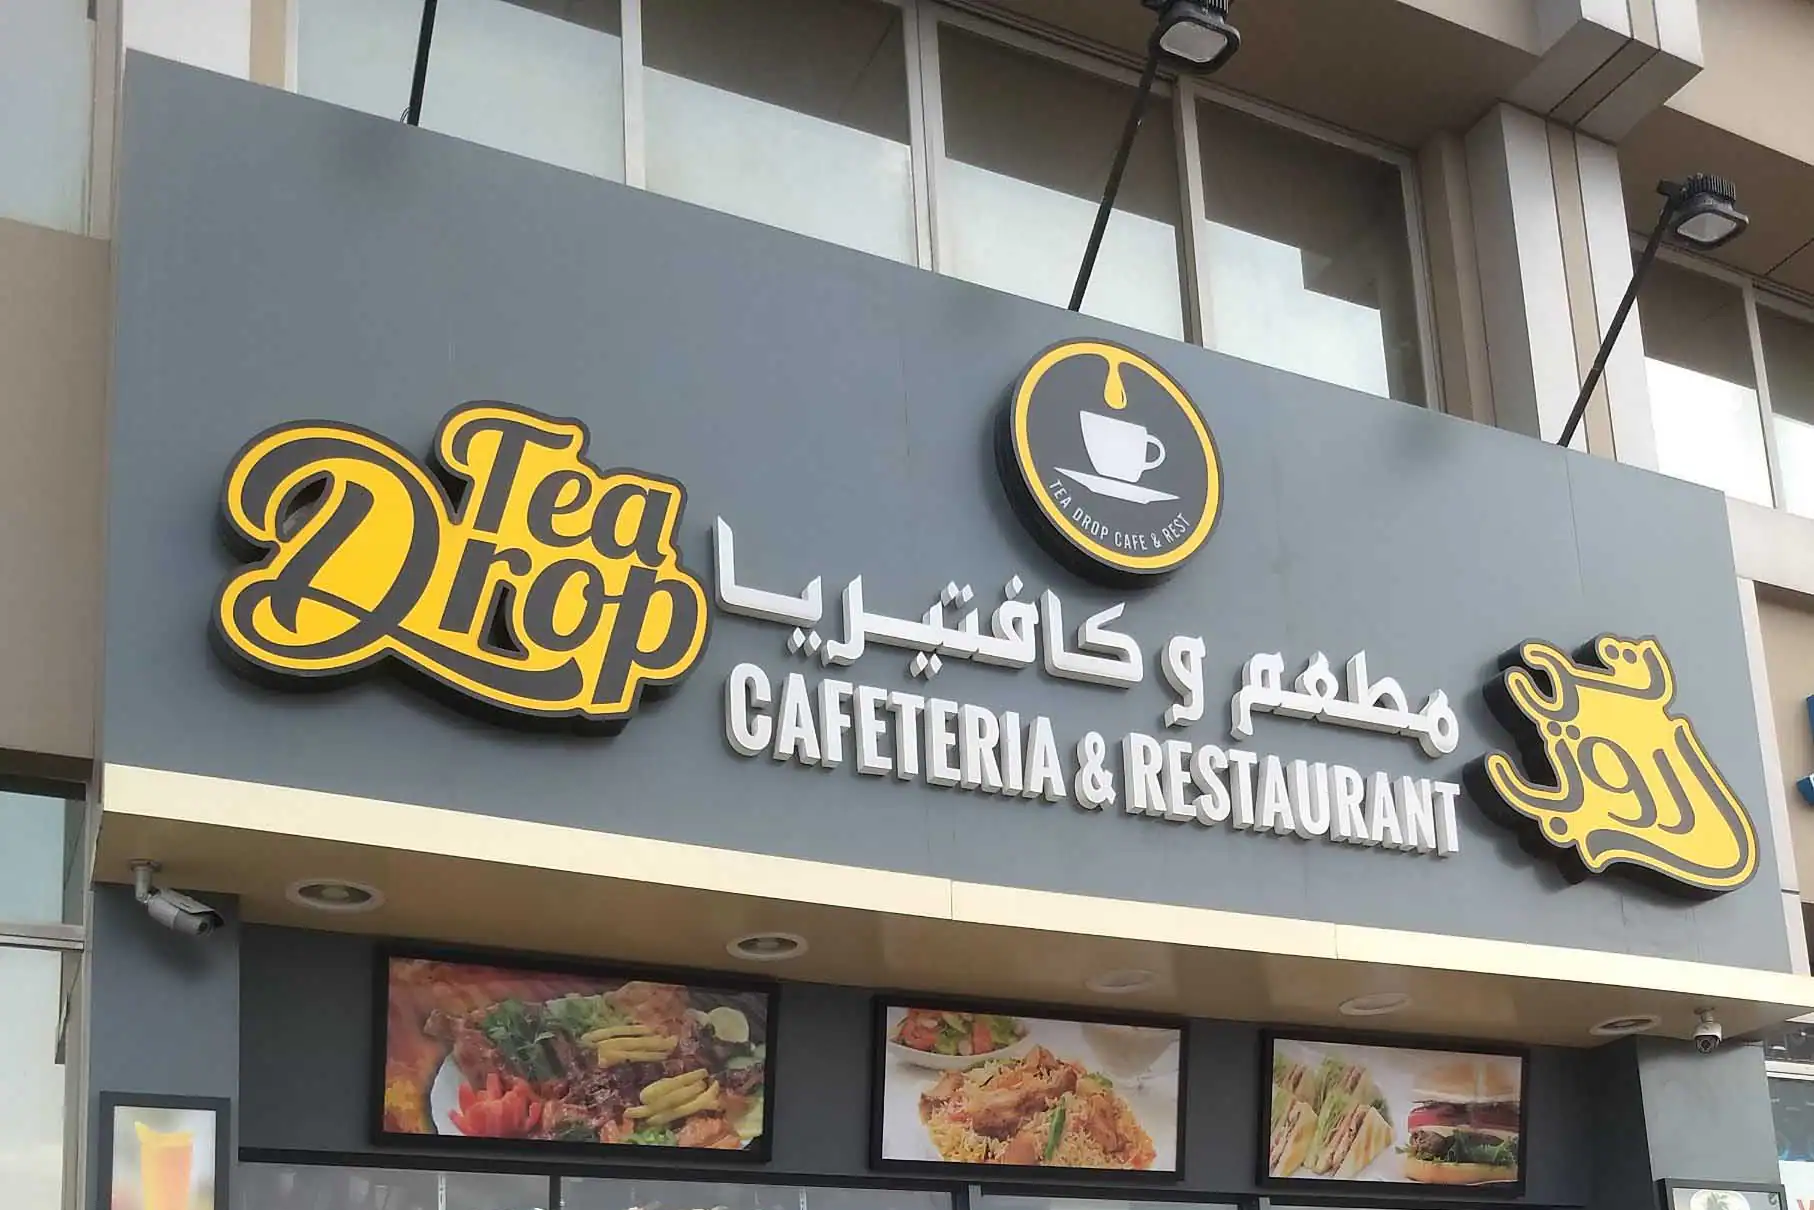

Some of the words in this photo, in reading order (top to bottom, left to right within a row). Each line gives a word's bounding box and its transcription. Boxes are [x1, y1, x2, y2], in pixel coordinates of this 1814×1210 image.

[231, 435, 700, 706] Drop
[450, 416, 674, 567] Tea
[1049, 479, 1070, 509] TEA
[1072, 508, 1109, 540] DROP
[1114, 531, 1148, 551] CAFE
[1151, 533, 1162, 549] &
[1162, 512, 1191, 543] REST
[712, 515, 1144, 690] كافتيريا
[725, 661, 1067, 802] CAFETERIA
[1074, 730, 1116, 810] &
[1122, 732, 1461, 857] RESTAURANT
[1231, 650, 1461, 758] مطعم
